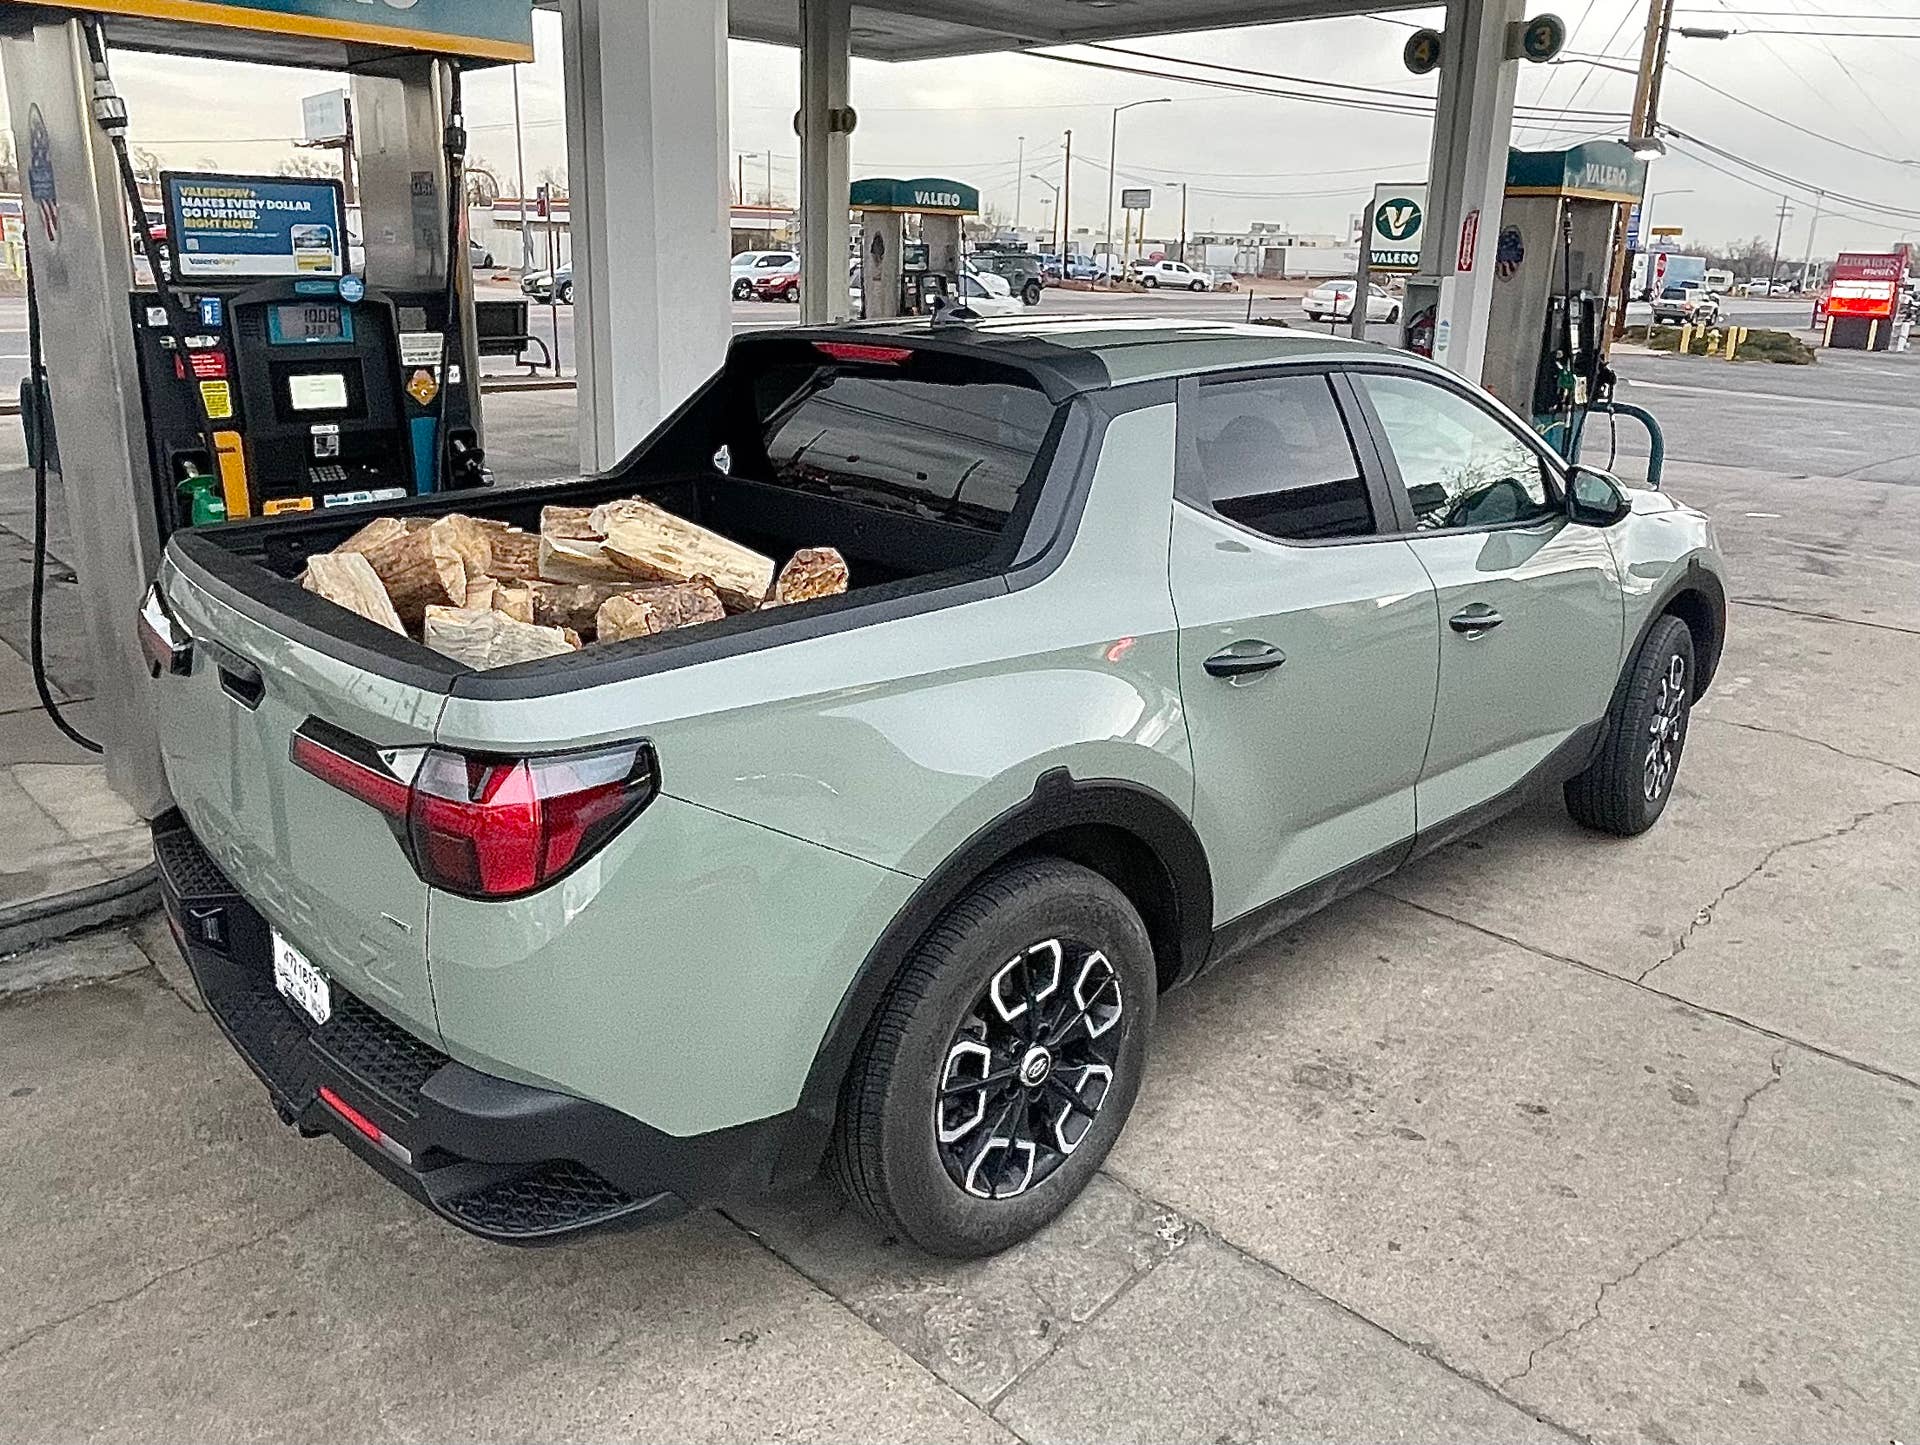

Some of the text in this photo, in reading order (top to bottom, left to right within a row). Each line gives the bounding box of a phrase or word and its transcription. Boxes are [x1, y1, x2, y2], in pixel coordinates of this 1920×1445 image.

[1535, 25, 1552, 51] 3
[1586, 162, 1628, 186] VALERO
[182, 197, 311, 211] MAKES EVERY DOLLAR
[914, 190, 961, 207] VALERO
[182, 208, 261, 220] GO FURTHER.
[184, 219, 221, 229] RIGHT
[1371, 252, 1419, 265] VALERO
